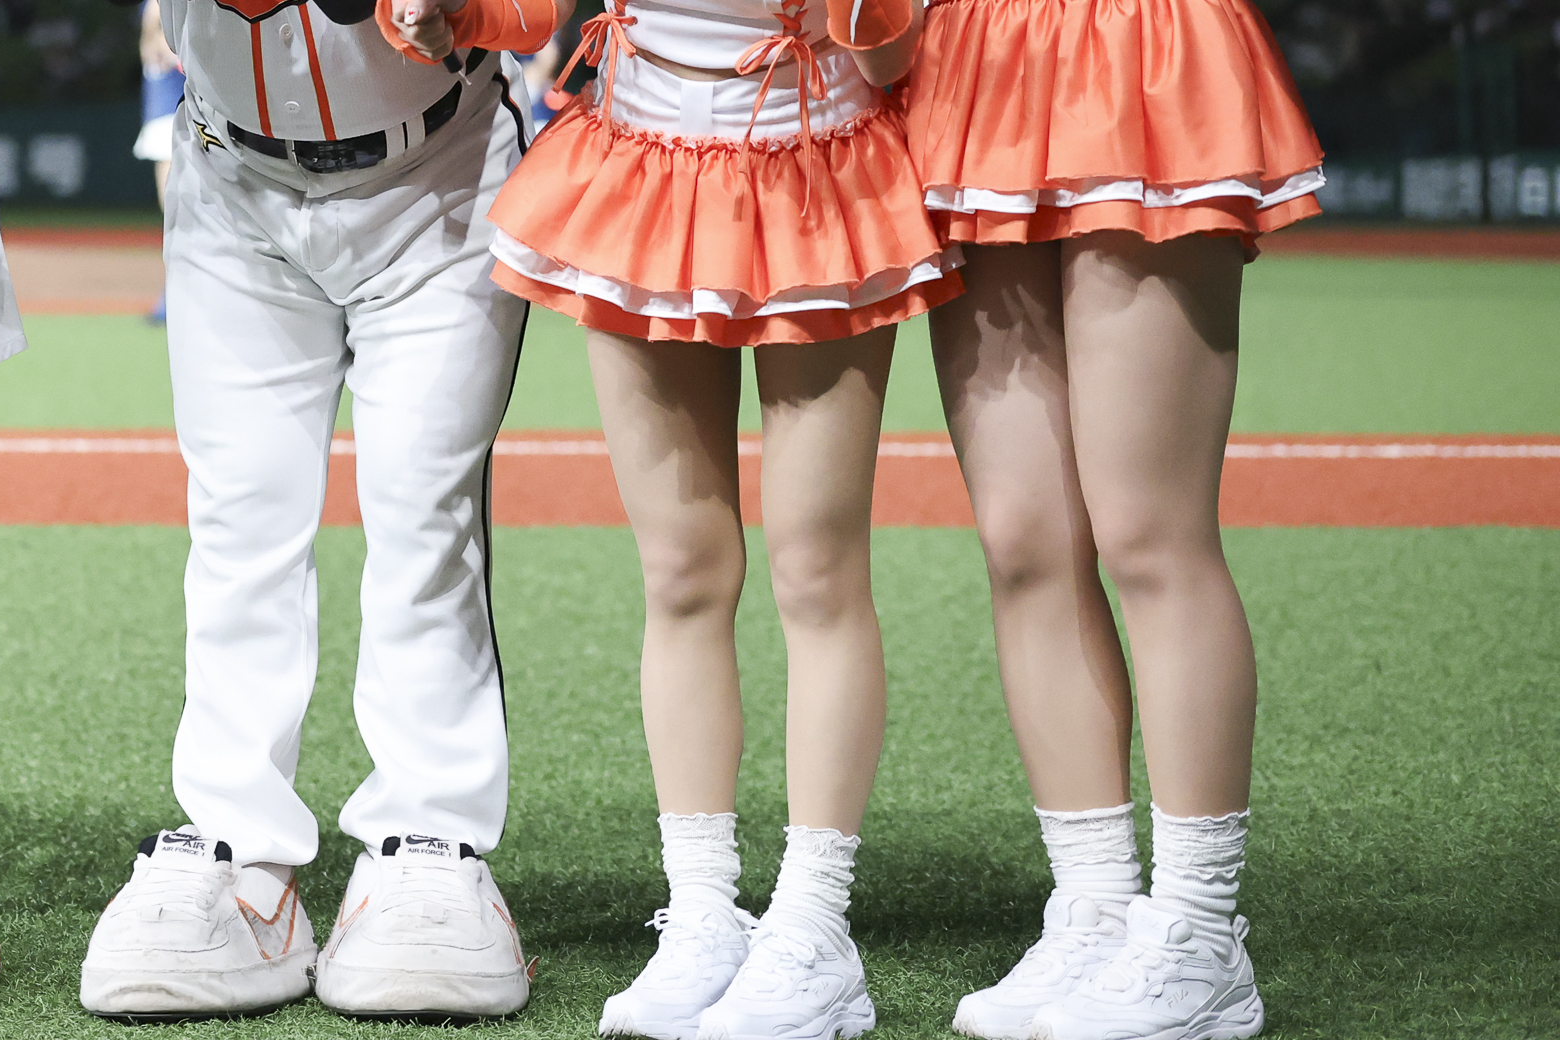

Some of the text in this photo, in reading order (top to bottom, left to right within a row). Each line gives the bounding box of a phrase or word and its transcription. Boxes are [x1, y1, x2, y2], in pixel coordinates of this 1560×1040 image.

[182, 840, 206, 850] AIR
[427, 840, 450, 851] AIR
[174, 847, 199, 856] FORCE
[420, 848, 446, 856] FORCE
[1164, 987, 1190, 1010] FILA
